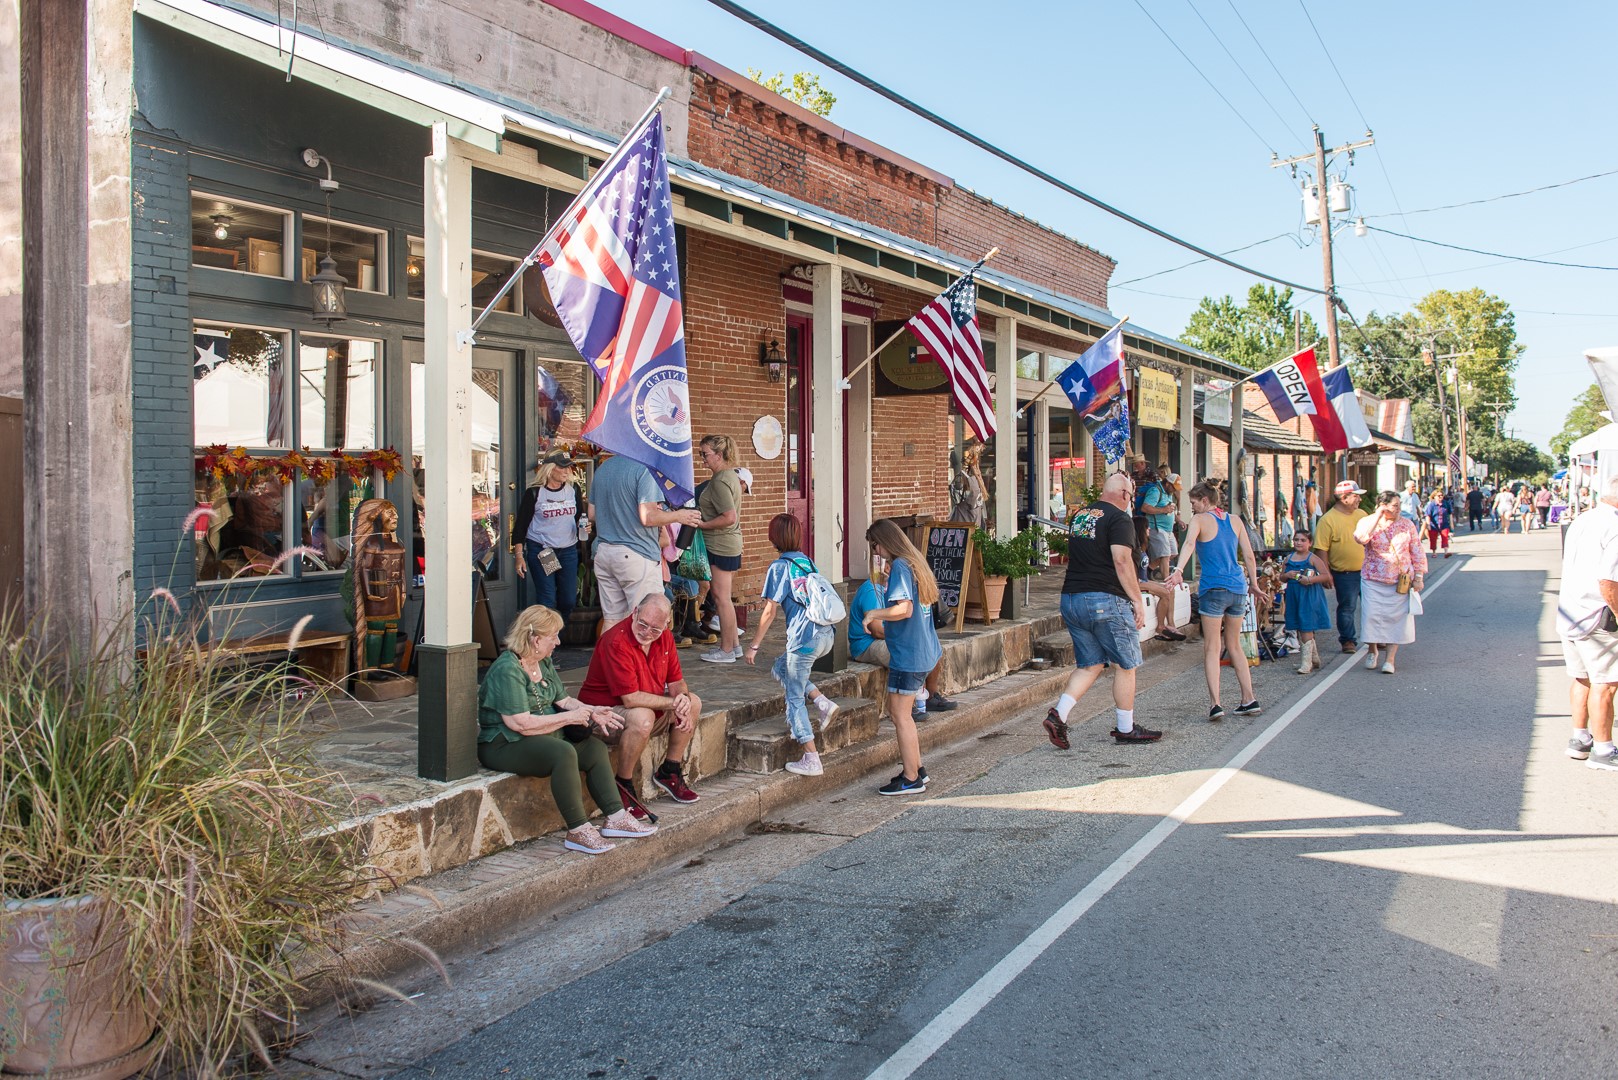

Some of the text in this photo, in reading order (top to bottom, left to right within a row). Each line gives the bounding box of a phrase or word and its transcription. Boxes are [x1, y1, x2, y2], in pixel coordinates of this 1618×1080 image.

[1141, 378, 1153, 390] exas
[1277, 364, 1311, 404] OPEN
[1143, 392, 1170, 413] Here Today!
[543, 507, 576, 518] STRAIT
[930, 528, 966, 547] OPEN
[927, 546, 965, 558] SOMETHING
[933, 558, 953, 569] FOR
[933, 569, 961, 581] ERYONE
